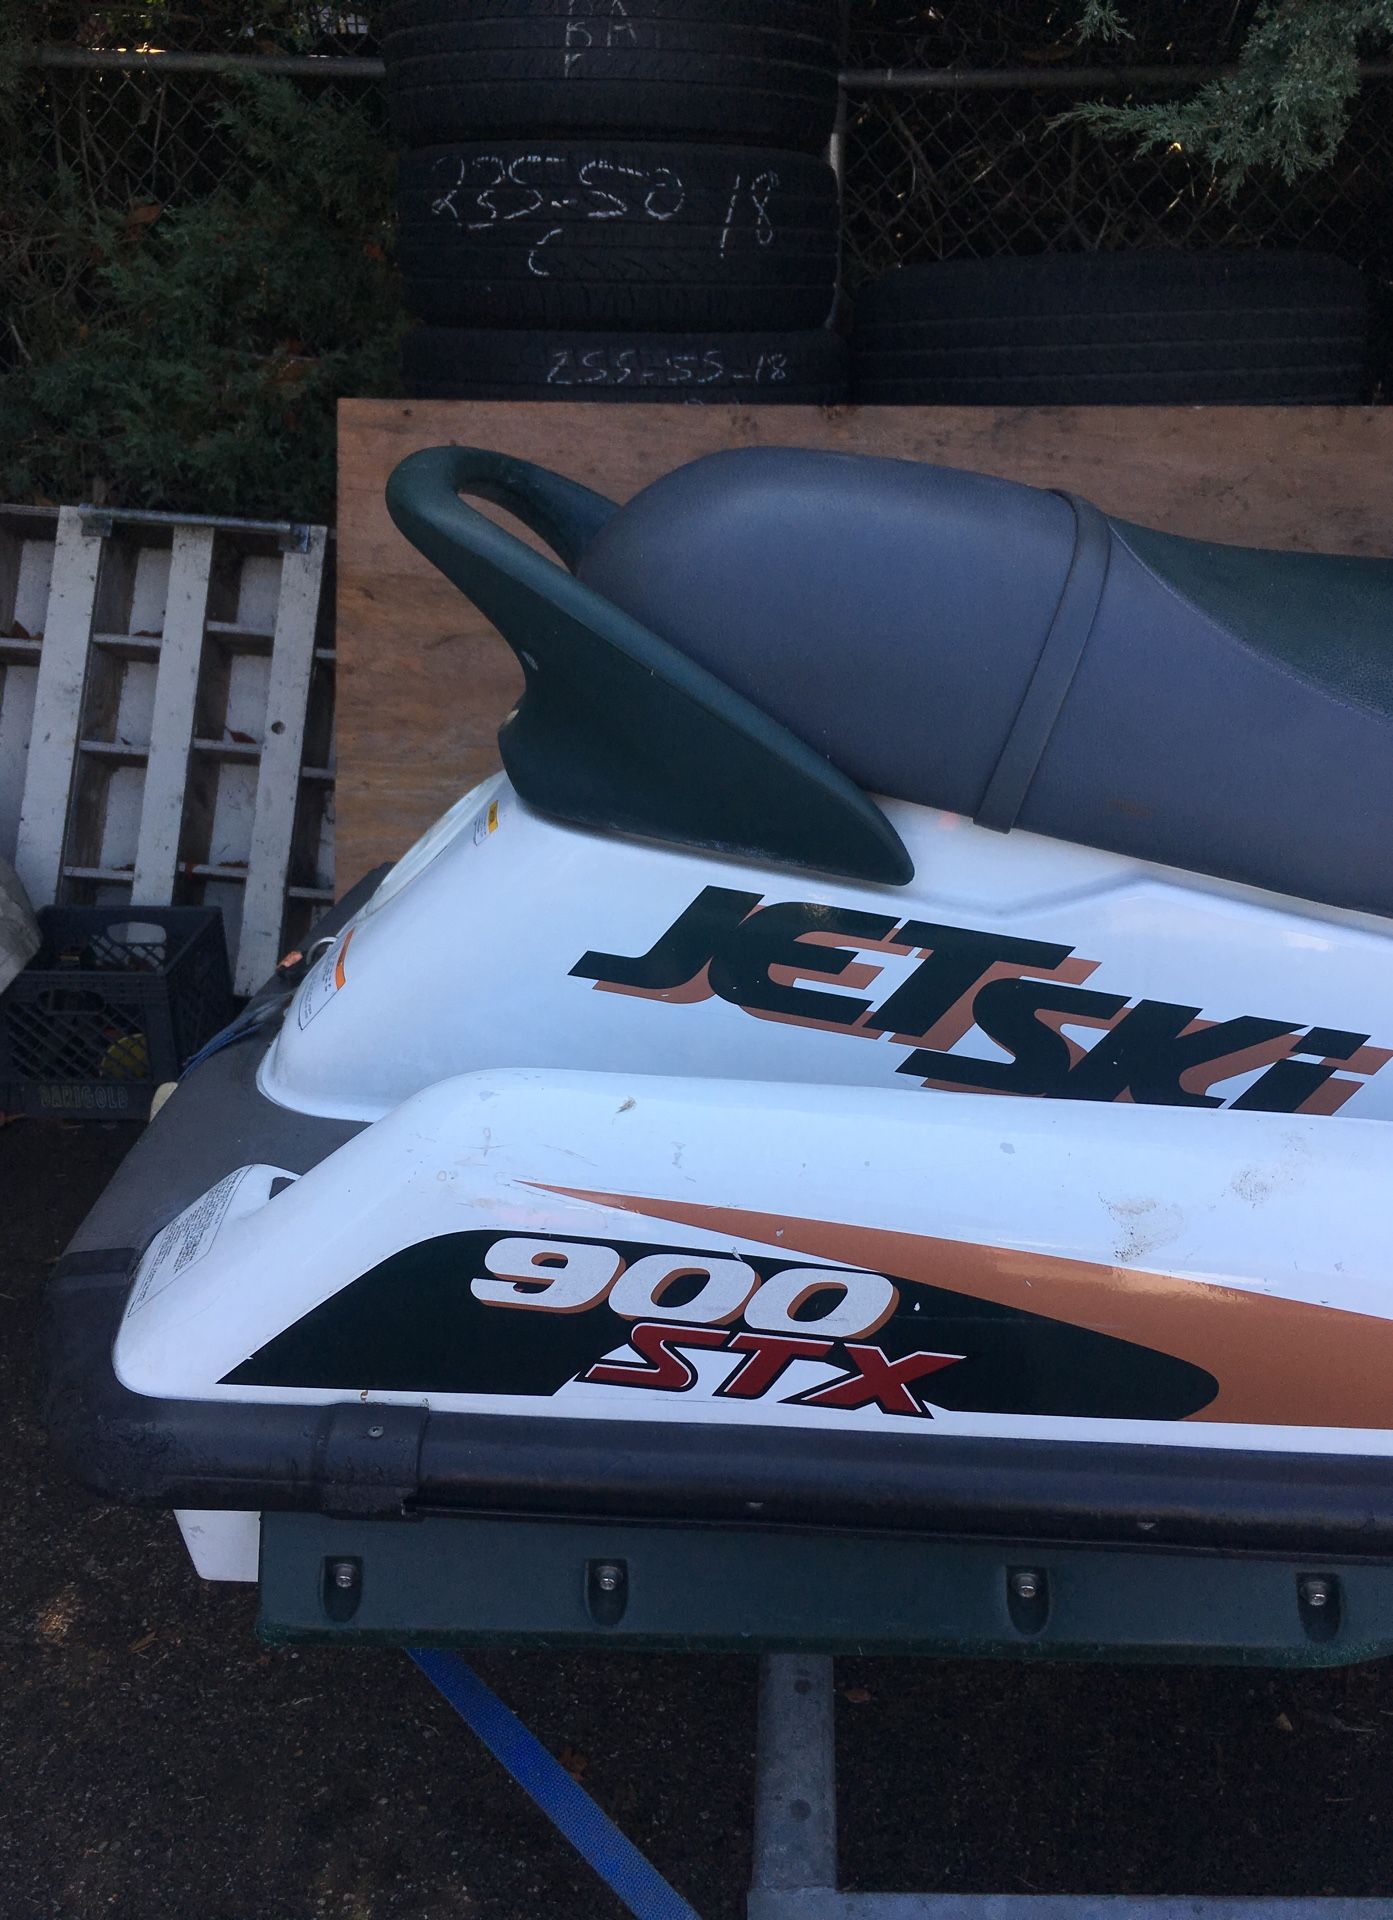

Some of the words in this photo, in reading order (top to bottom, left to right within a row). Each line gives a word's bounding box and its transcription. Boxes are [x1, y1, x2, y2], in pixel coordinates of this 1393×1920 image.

[719, 170, 779, 259] 18
[568, 885, 1088, 1045] JET
[470, 1238, 900, 1340] 900
[578, 1323, 966, 1418] STX
